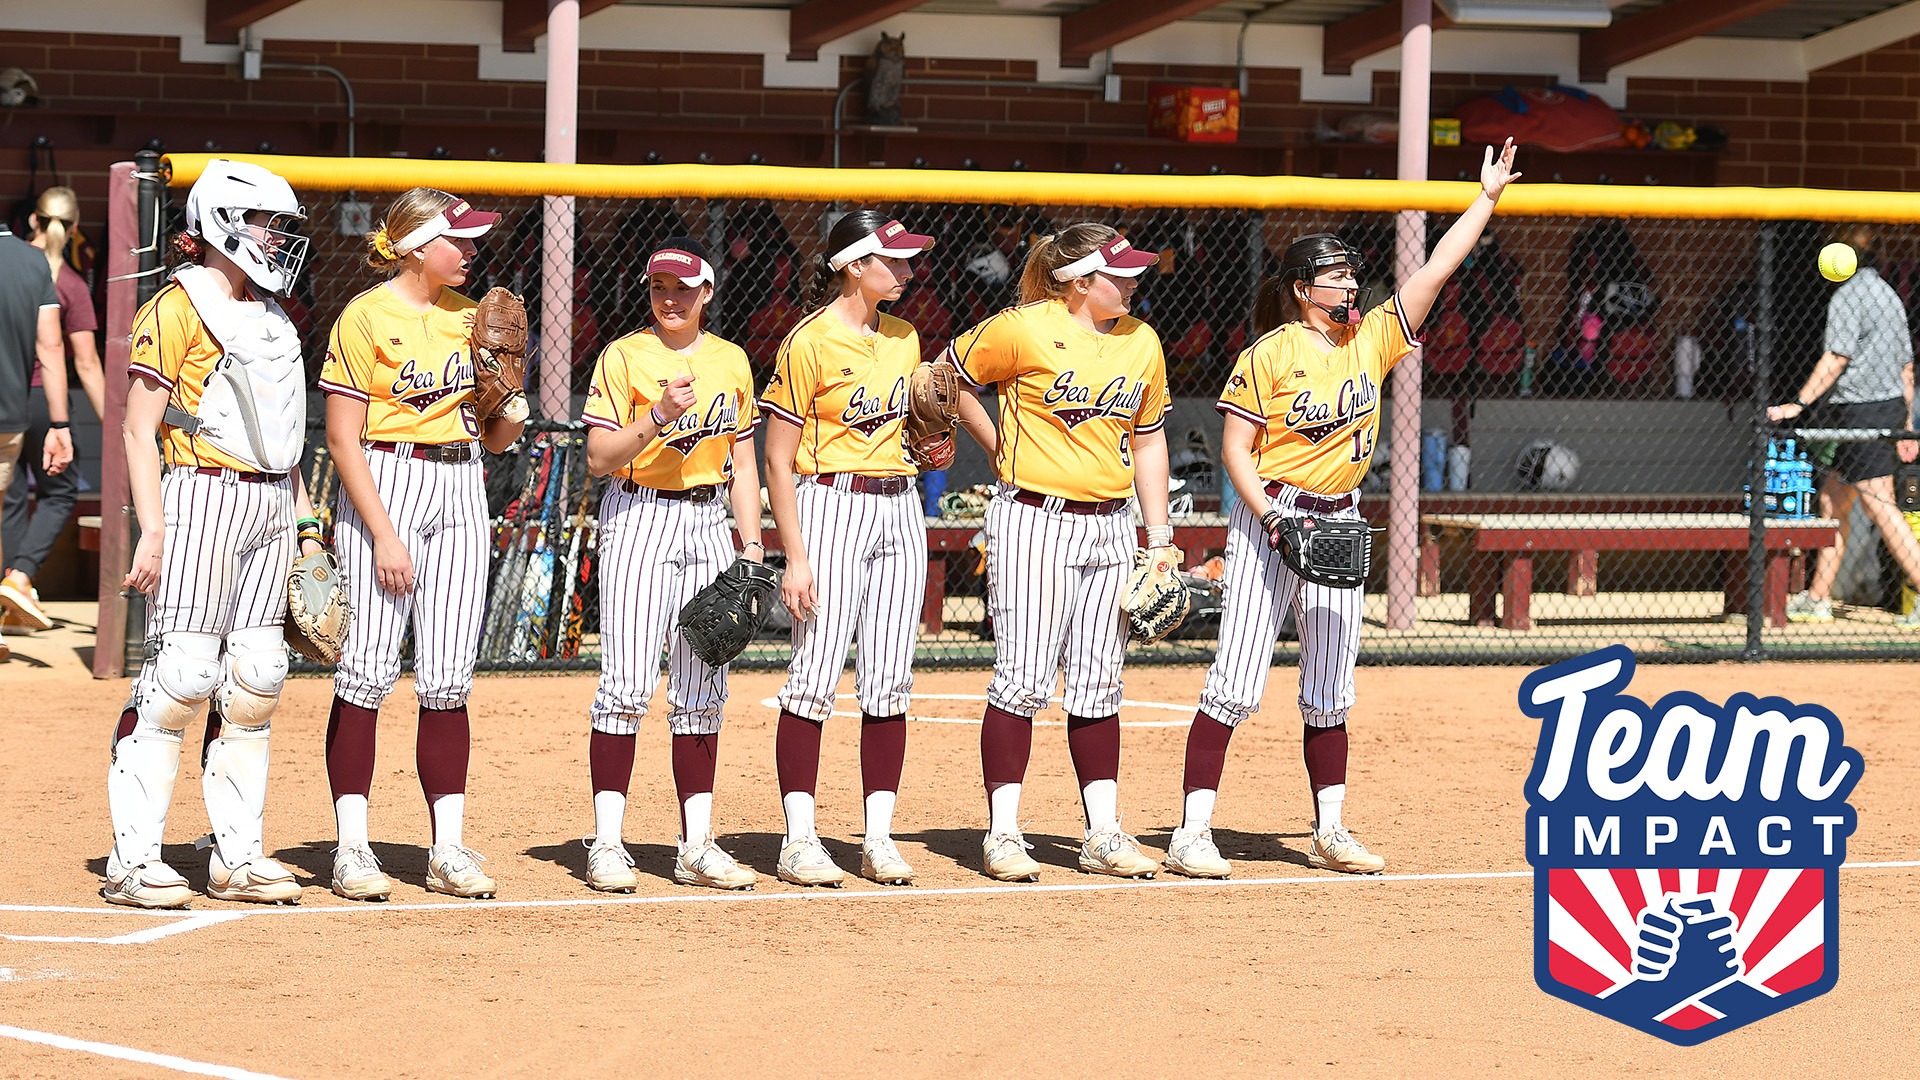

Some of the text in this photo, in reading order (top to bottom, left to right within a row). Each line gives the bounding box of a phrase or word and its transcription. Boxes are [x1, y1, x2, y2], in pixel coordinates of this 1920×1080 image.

[390, 358, 436, 396] Sea
[1043, 370, 1090, 406] Sea
[702, 391, 739, 437] Gull
[840, 385, 882, 424] Sea
[1283, 371, 1376, 428] Sea Gulls
[459, 401, 481, 440] 6
[1119, 431, 1132, 468] 9
[1349, 424, 1375, 464] 15
